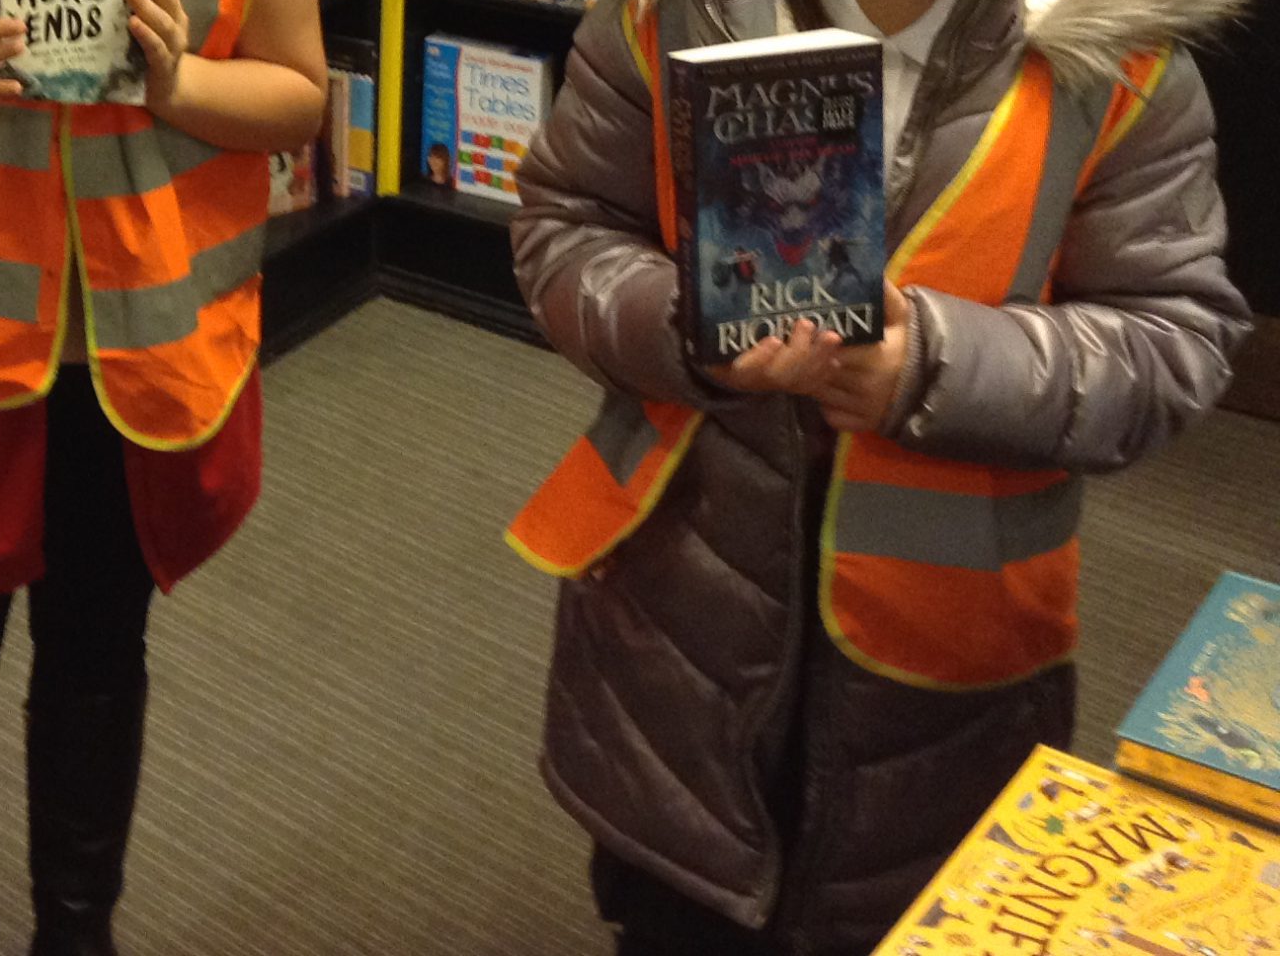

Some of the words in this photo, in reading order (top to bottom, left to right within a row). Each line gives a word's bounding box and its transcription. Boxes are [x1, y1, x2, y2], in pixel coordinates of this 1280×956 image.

[25, 5, 103, 45] ENDS
[465, 62, 531, 95] Times
[463, 86, 536, 123] Tables
[712, 104, 818, 145] CHAS
[750, 273, 838, 316] RICK
[983, 812, 1181, 956] MAGNIF
